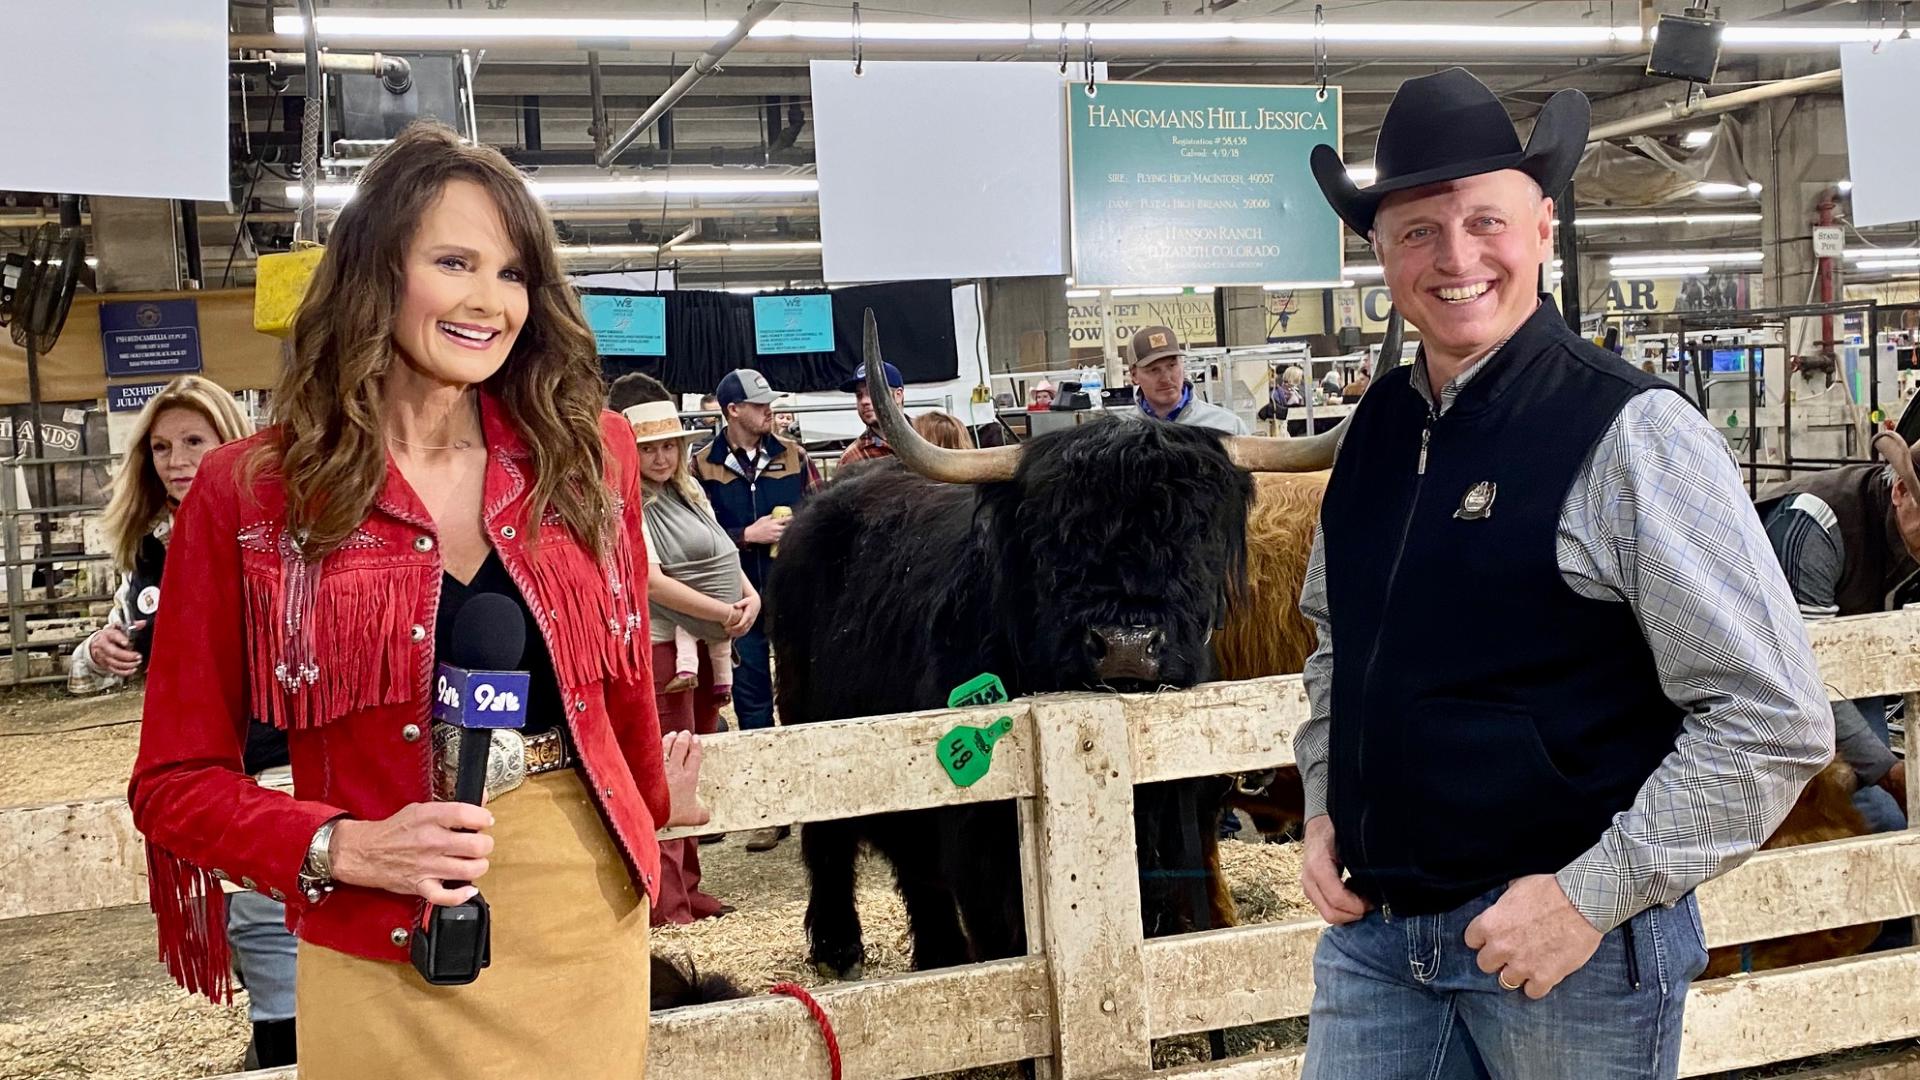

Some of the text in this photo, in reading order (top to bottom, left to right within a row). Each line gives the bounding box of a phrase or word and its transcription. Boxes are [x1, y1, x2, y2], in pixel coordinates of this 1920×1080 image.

[1087, 104, 1328, 130] HANGMANS HILL JESSICA
[1172, 135, 1213, 146] Registration
[1219, 225, 1262, 240] RANCH
[1818, 231, 1840, 240] STAND
[1211, 244, 1281, 257] COLORADO
[1147, 302, 1212, 318] NATIONA
[116, 397, 145, 407] JULIA
[950, 739, 974, 770] 48
